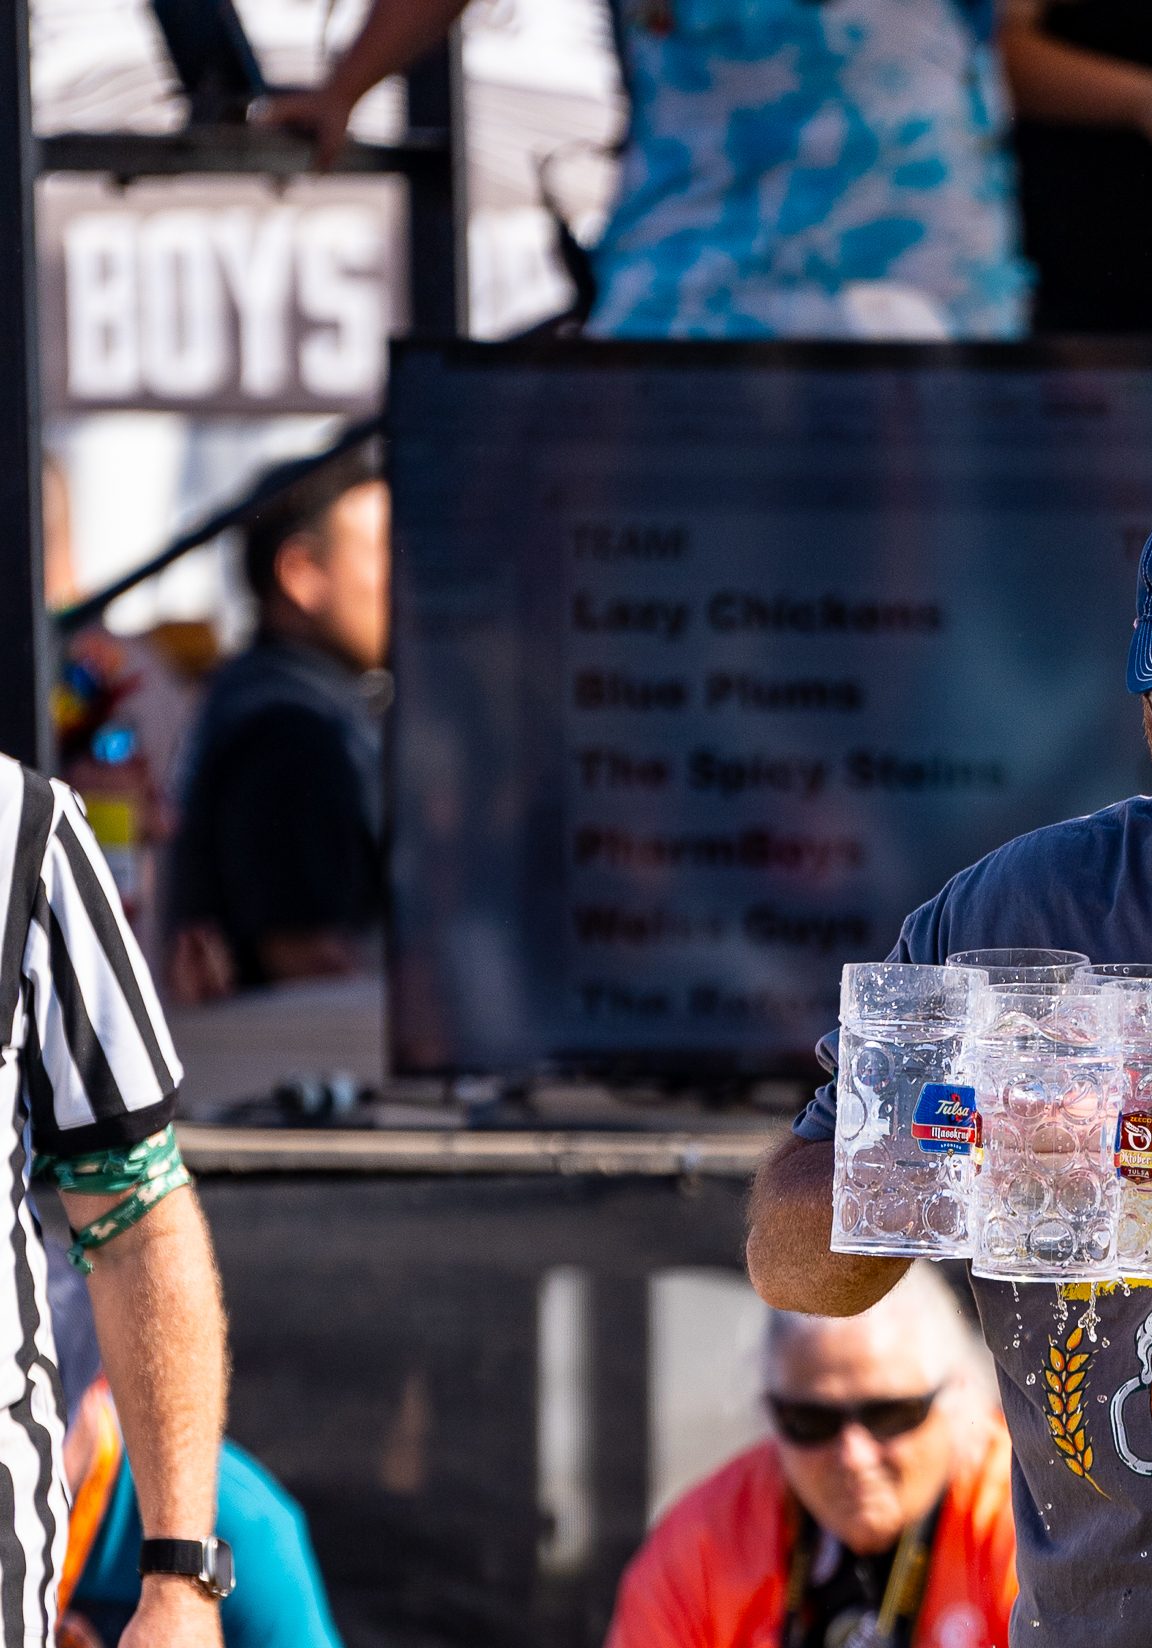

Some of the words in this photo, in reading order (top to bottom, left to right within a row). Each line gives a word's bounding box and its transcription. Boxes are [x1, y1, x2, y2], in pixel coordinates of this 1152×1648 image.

[64, 206, 386, 402] BOYS
[572, 526, 690, 560] TEAM
[705, 590, 946, 635] Chickens
[573, 669, 689, 712] Blue
[575, 747, 672, 789] The
[687, 747, 831, 801] Spicy
[935, 1100, 969, 1116] Tulsa
